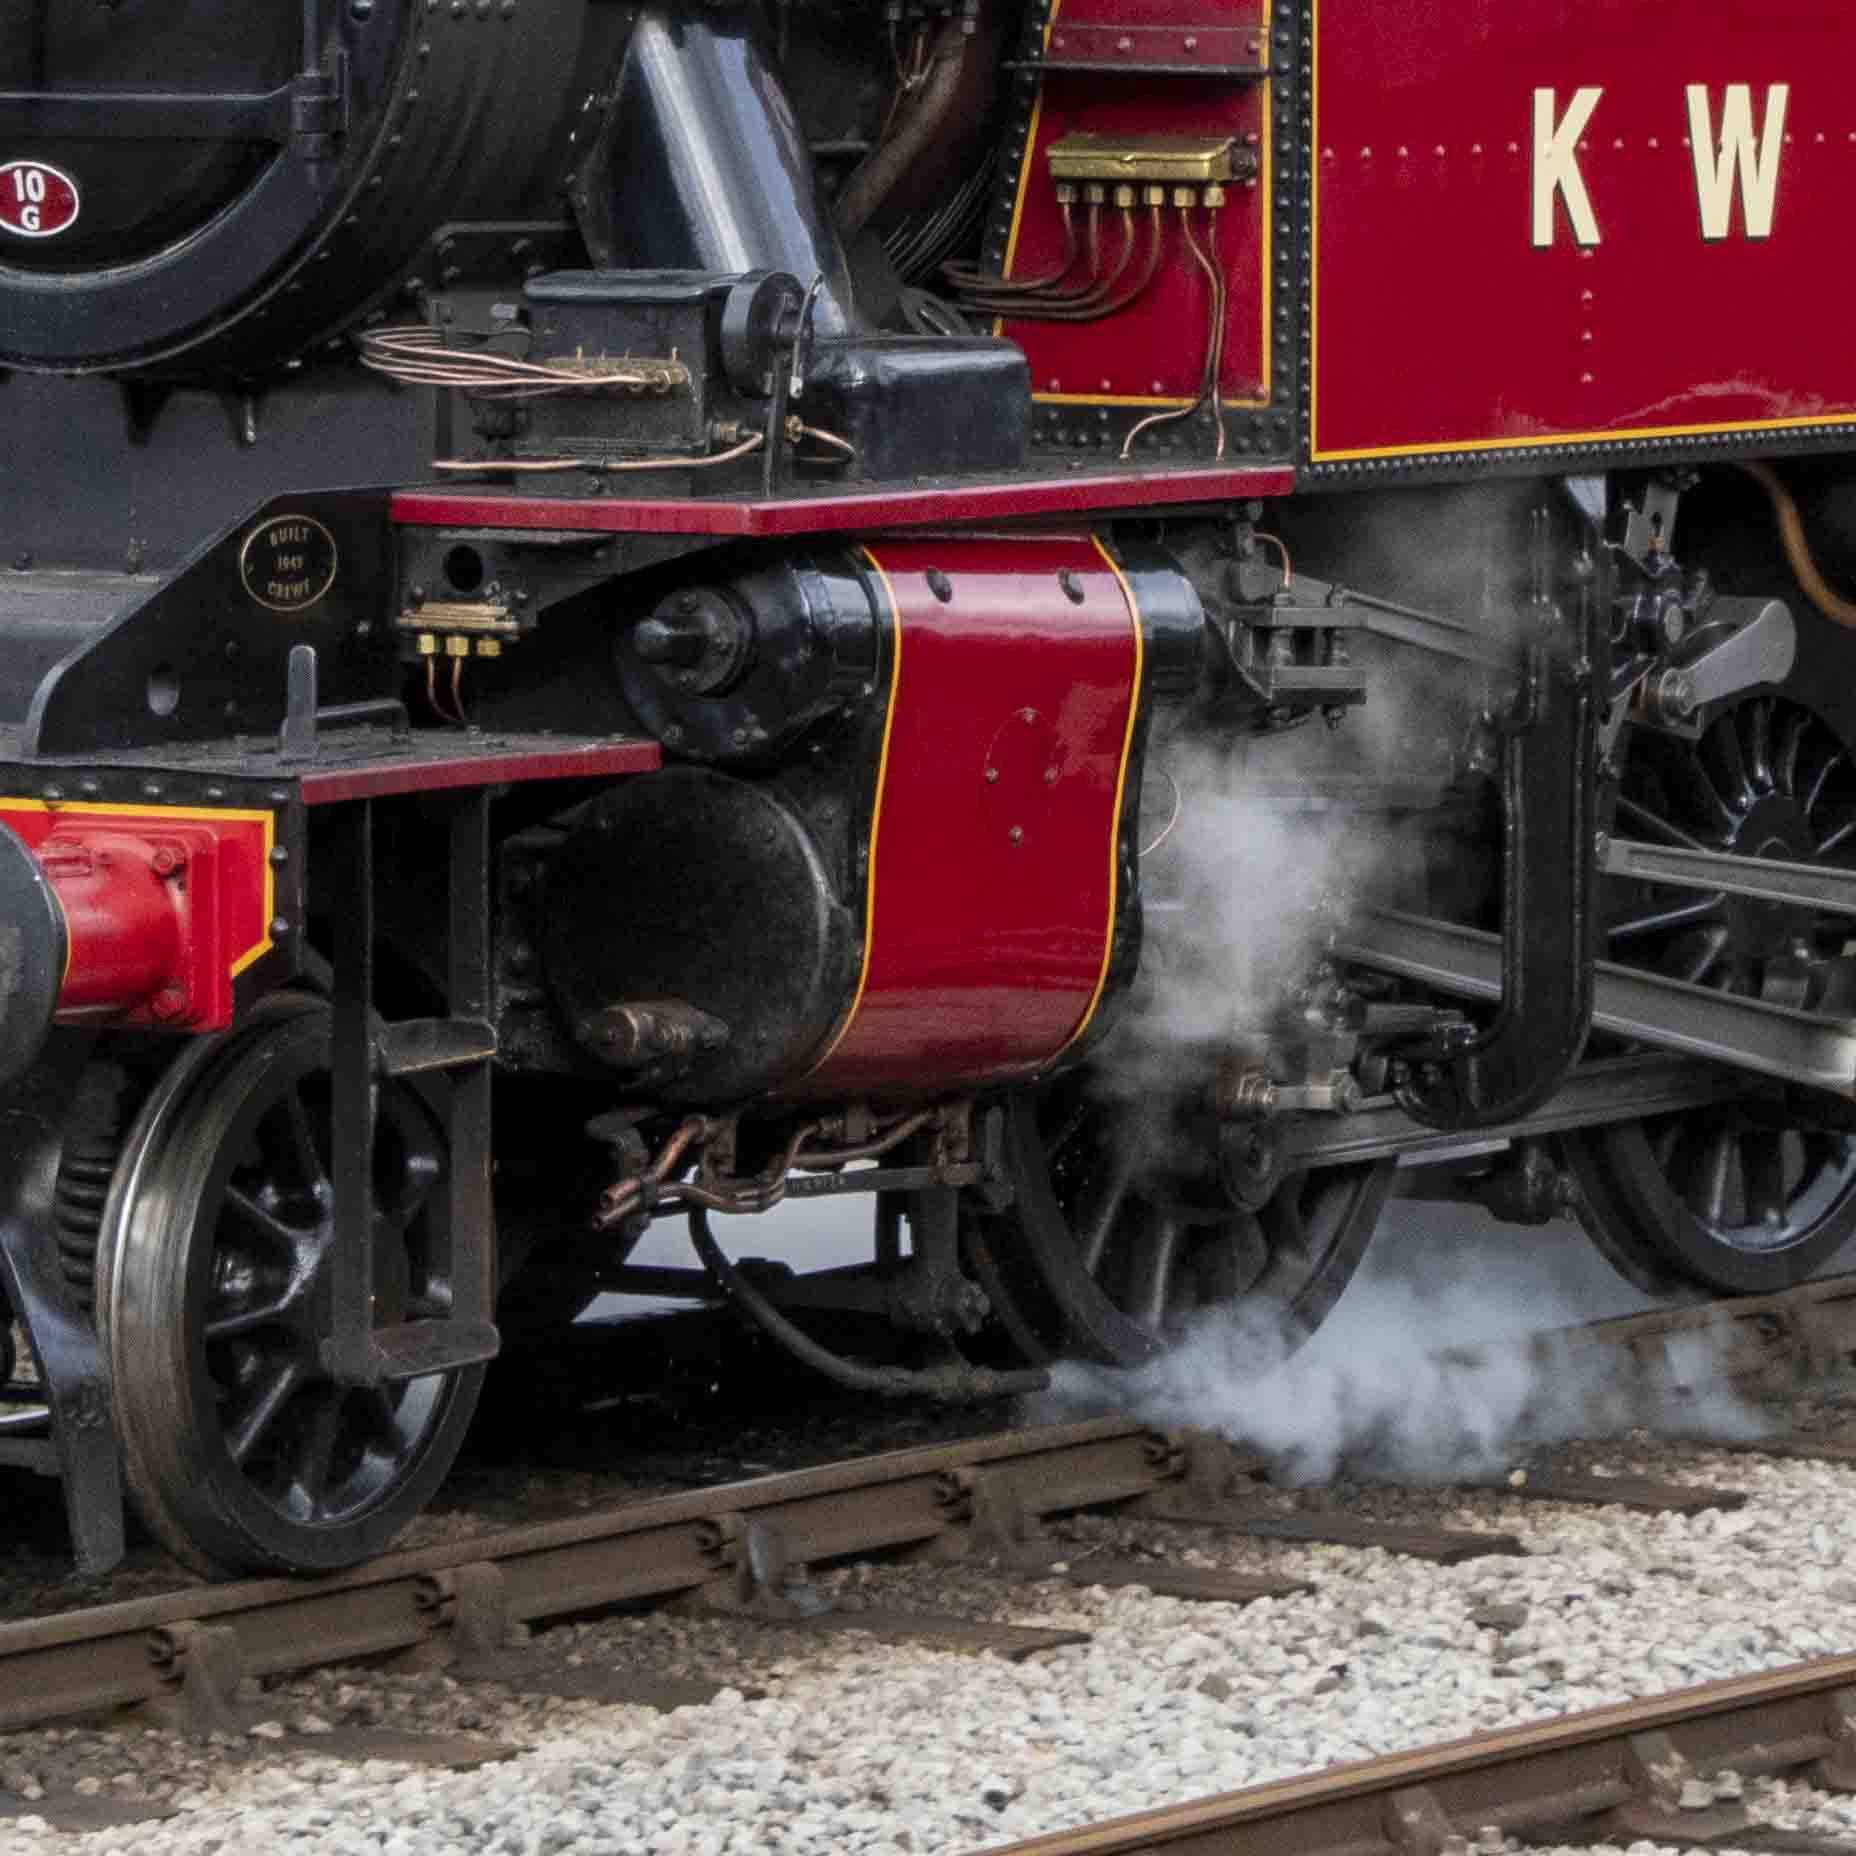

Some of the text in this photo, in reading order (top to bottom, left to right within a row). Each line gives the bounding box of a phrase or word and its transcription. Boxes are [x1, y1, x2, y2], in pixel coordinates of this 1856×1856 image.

[1532, 87, 1603, 248] K
[1684, 83, 1789, 243] W
[13, 167, 46, 203] 10
[21, 205, 41, 231] G
[269, 525, 311, 547] BUILT
[266, 576, 311, 600] CREWE
